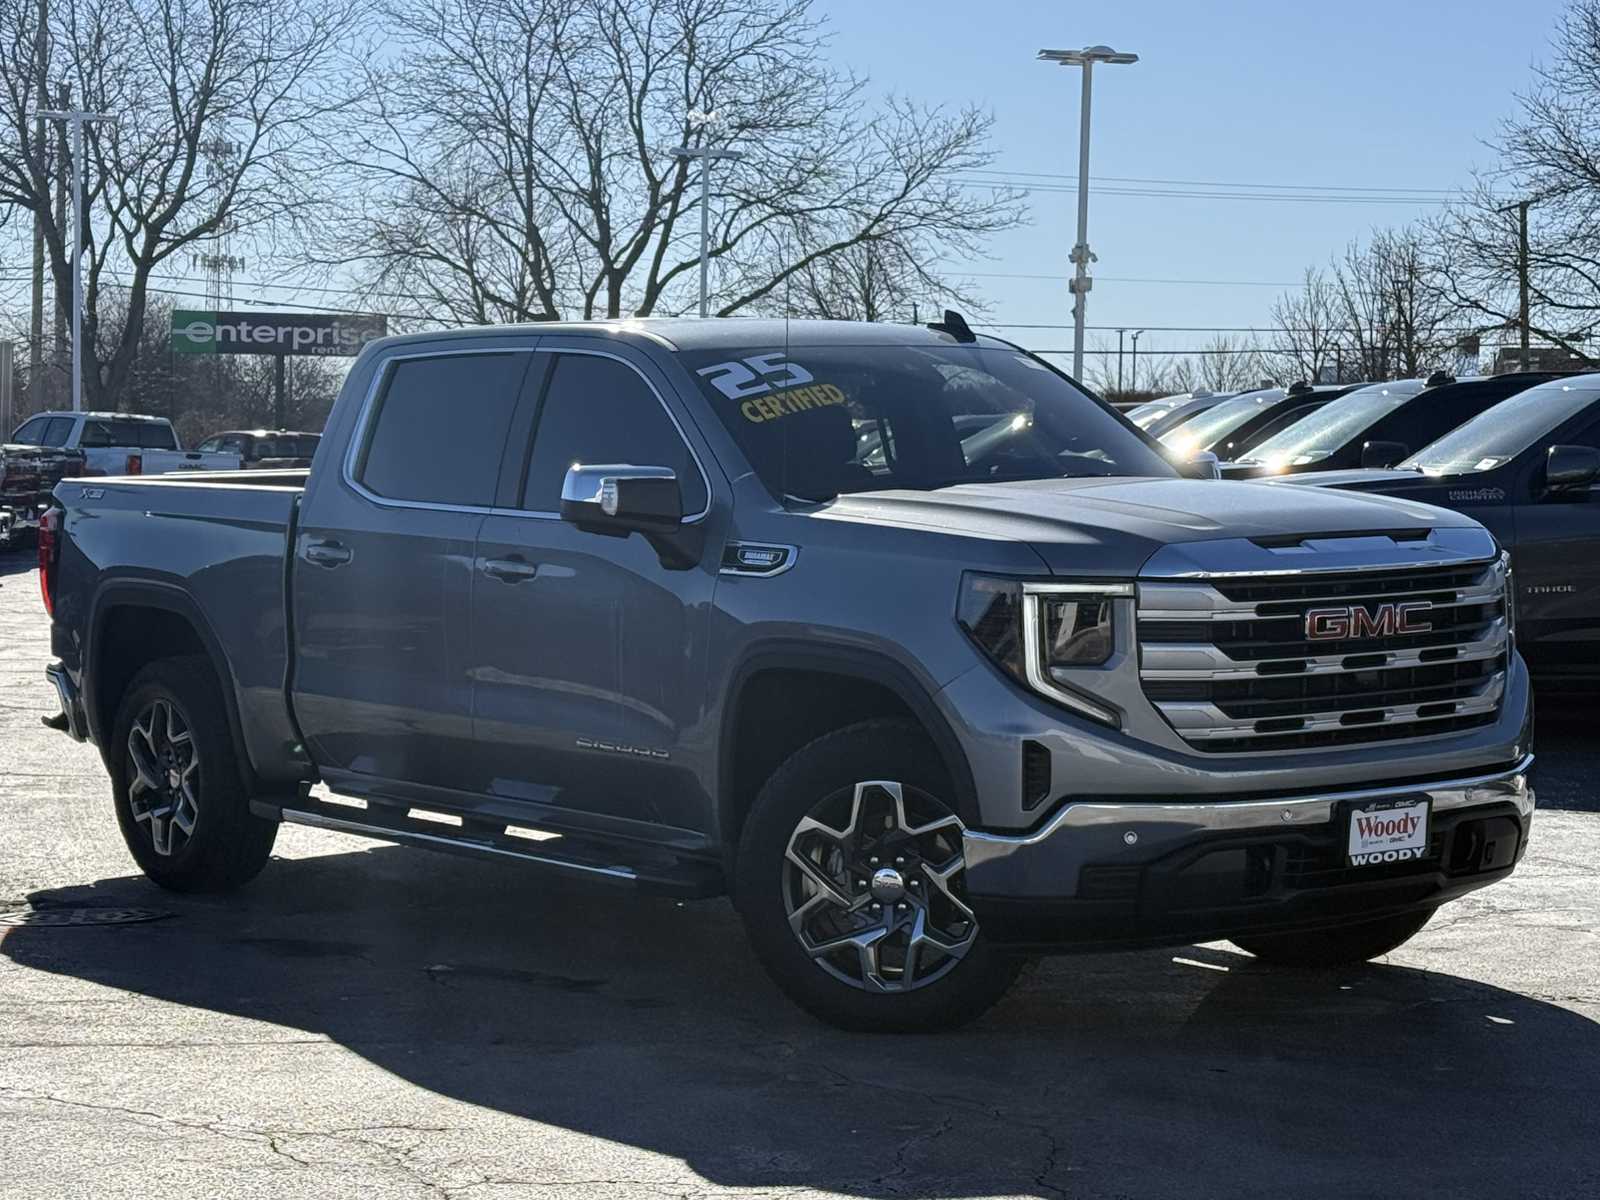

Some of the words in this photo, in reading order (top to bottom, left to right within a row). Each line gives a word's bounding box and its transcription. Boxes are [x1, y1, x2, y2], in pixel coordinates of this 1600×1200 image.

[173, 321, 380, 350] enterprise
[695, 352, 814, 400] 25
[741, 383, 845, 423] CERTIFIED
[1305, 601, 1433, 641] GMC
[1394, 799, 1416, 808] GMC
[1356, 812, 1421, 839] Woody
[1350, 847, 1426, 867] WOODY
